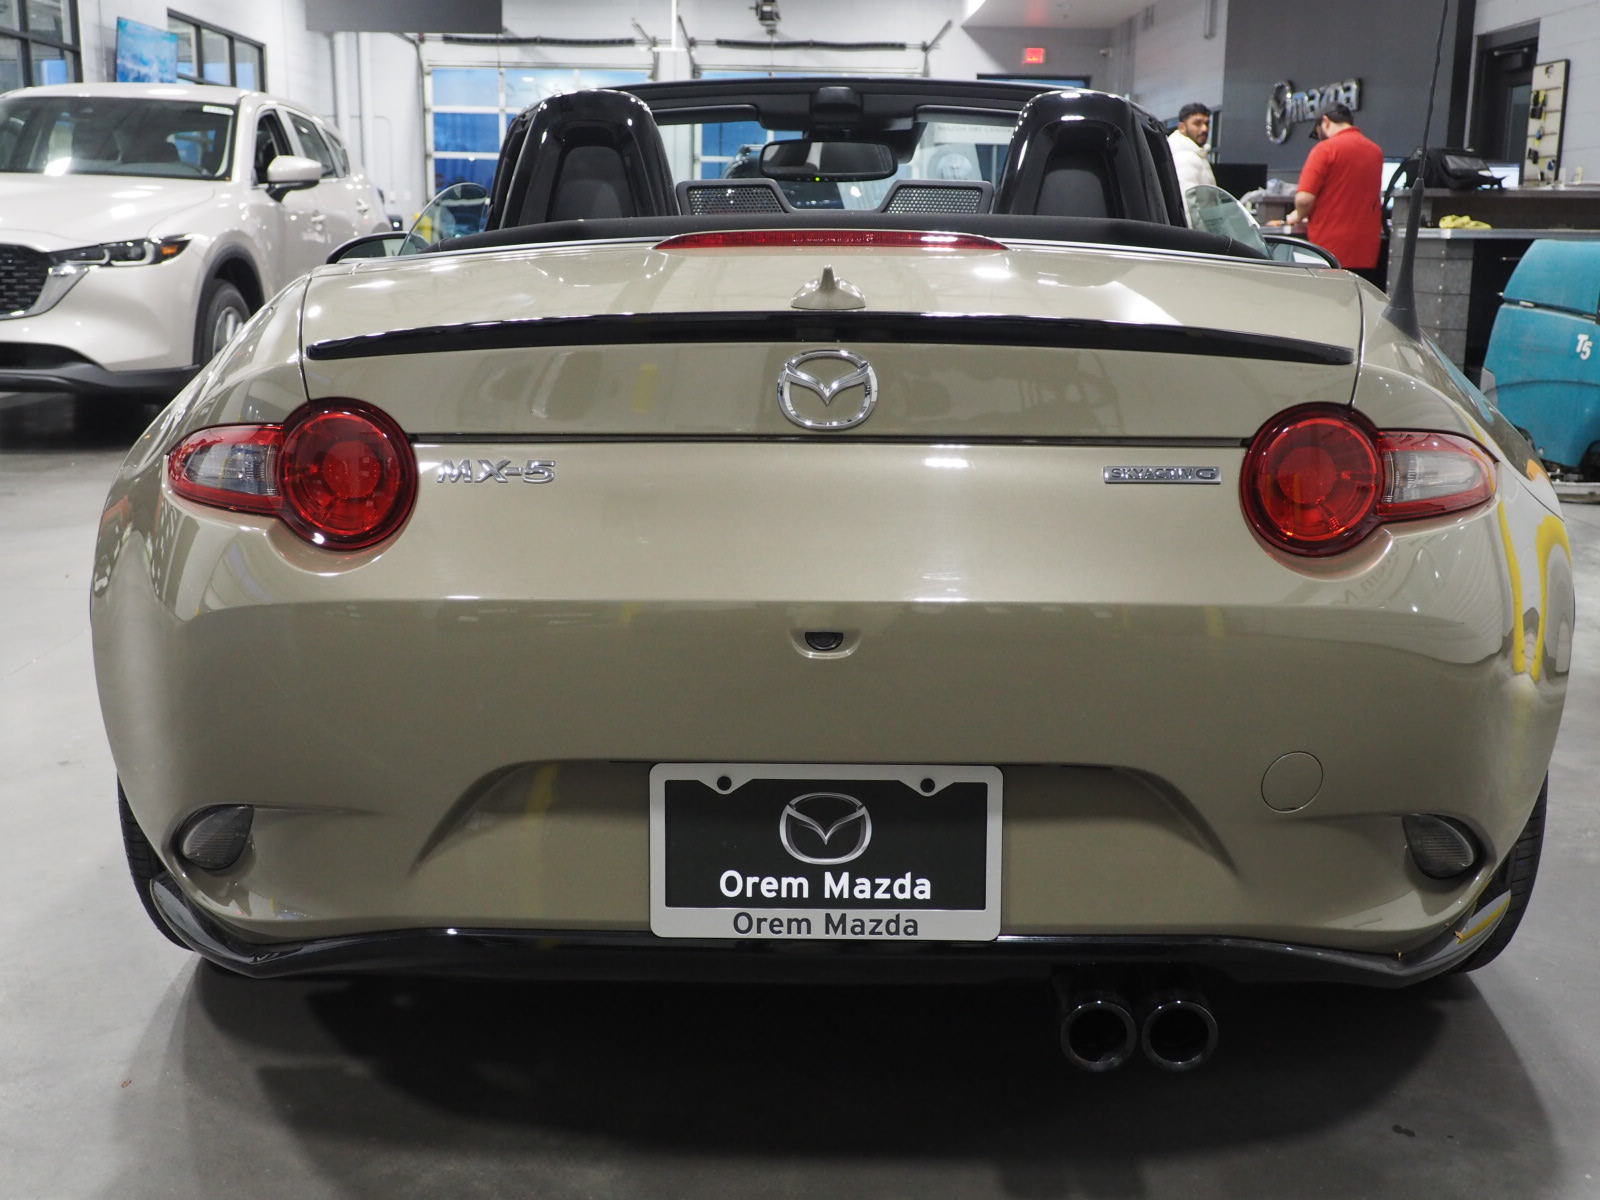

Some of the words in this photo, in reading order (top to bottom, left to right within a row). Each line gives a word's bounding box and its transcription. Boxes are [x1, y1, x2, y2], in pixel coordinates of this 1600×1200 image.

[1576, 333, 1593, 361] T5
[436, 459, 556, 484] MX-5
[1111, 467, 1193, 480] SKYACTIV
[719, 869, 809, 898] Orem
[824, 871, 932, 900] Mazda
[732, 911, 812, 935] Orem
[824, 912, 919, 936] Mazda
